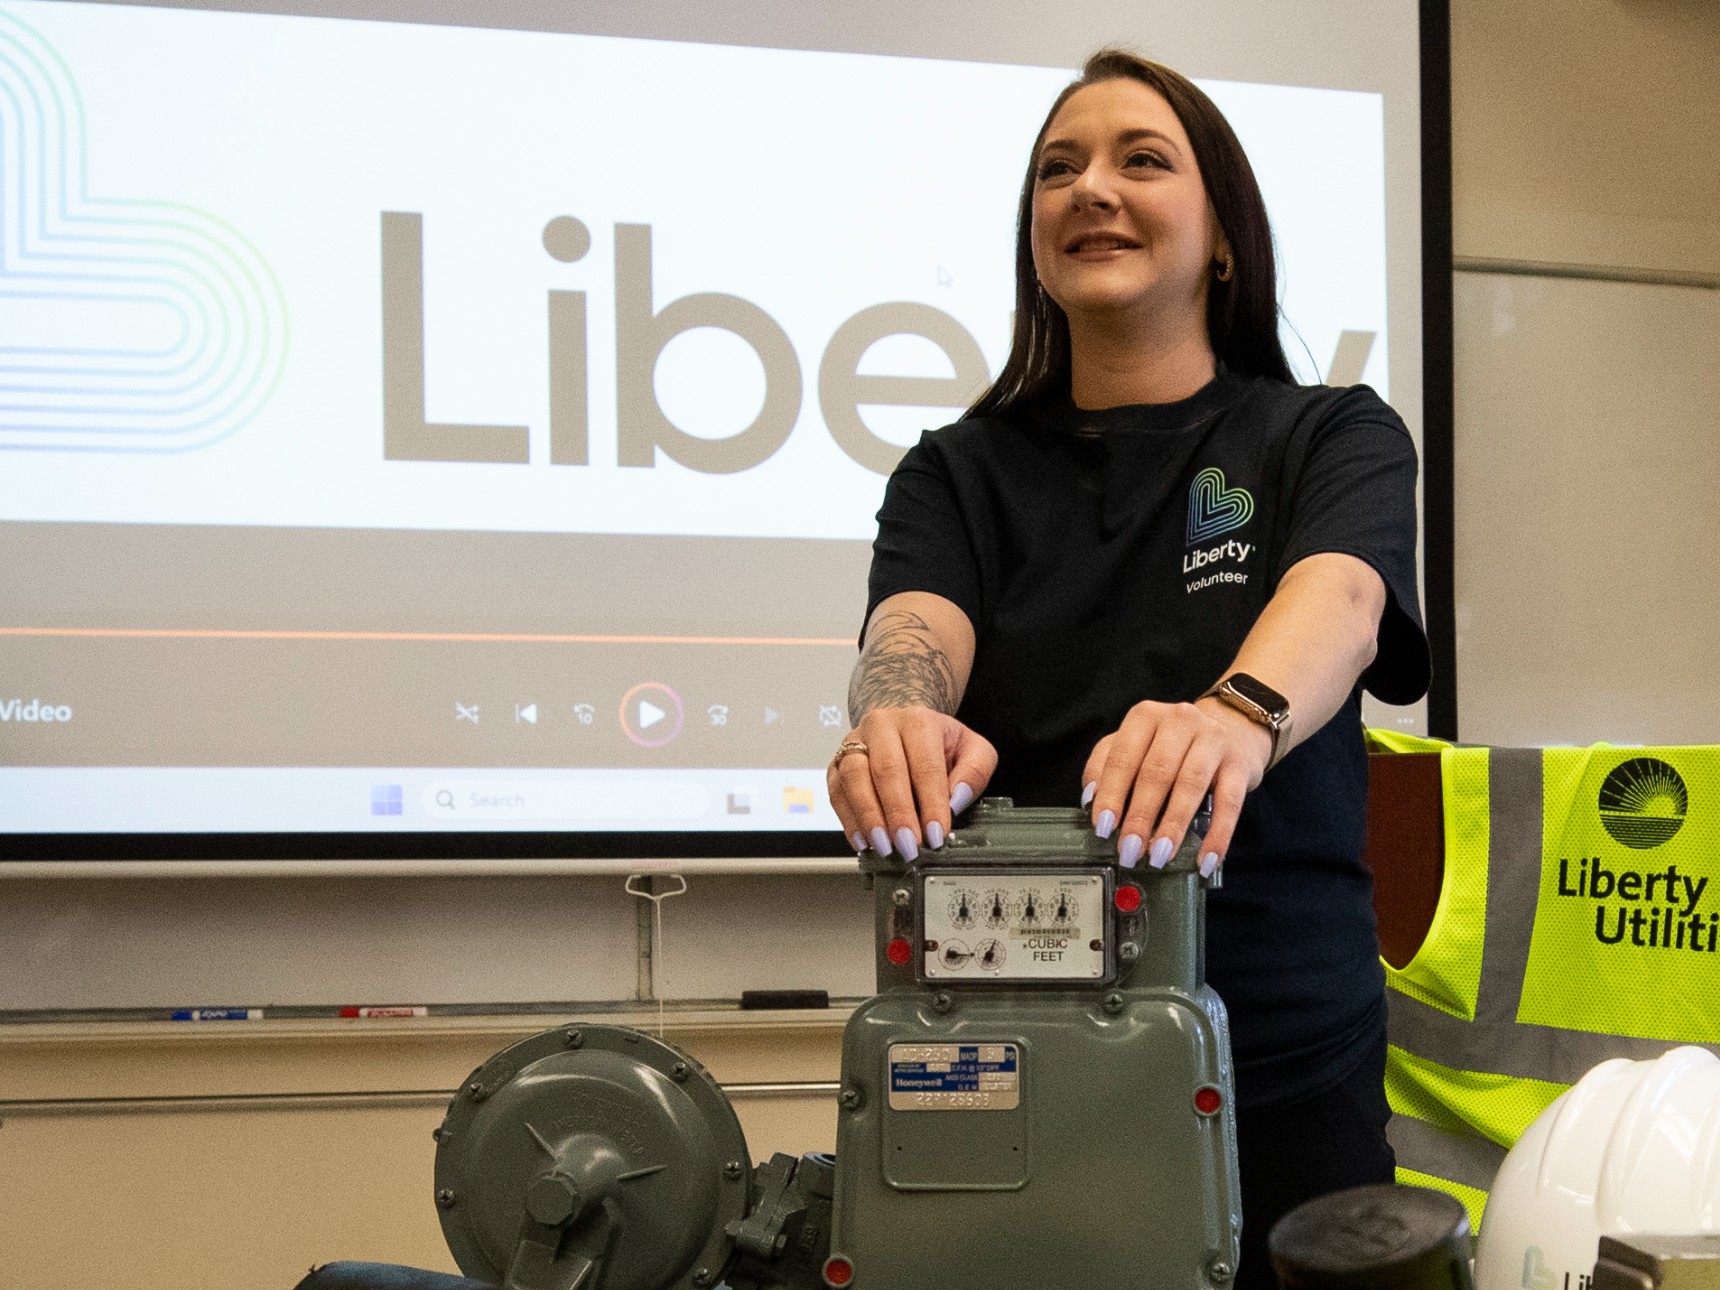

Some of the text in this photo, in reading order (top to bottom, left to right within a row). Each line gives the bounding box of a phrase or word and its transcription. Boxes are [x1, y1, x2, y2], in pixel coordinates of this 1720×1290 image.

[380, 210, 1377, 477] Libe
[1183, 539, 1252, 574] Liberty
[469, 792, 525, 809] Search
[1558, 857, 1709, 918] Liberty
[1028, 938, 1068, 949] CUBIC
[1033, 951, 1065, 962] FEET
[896, 1078, 943, 1089] Honeywell
